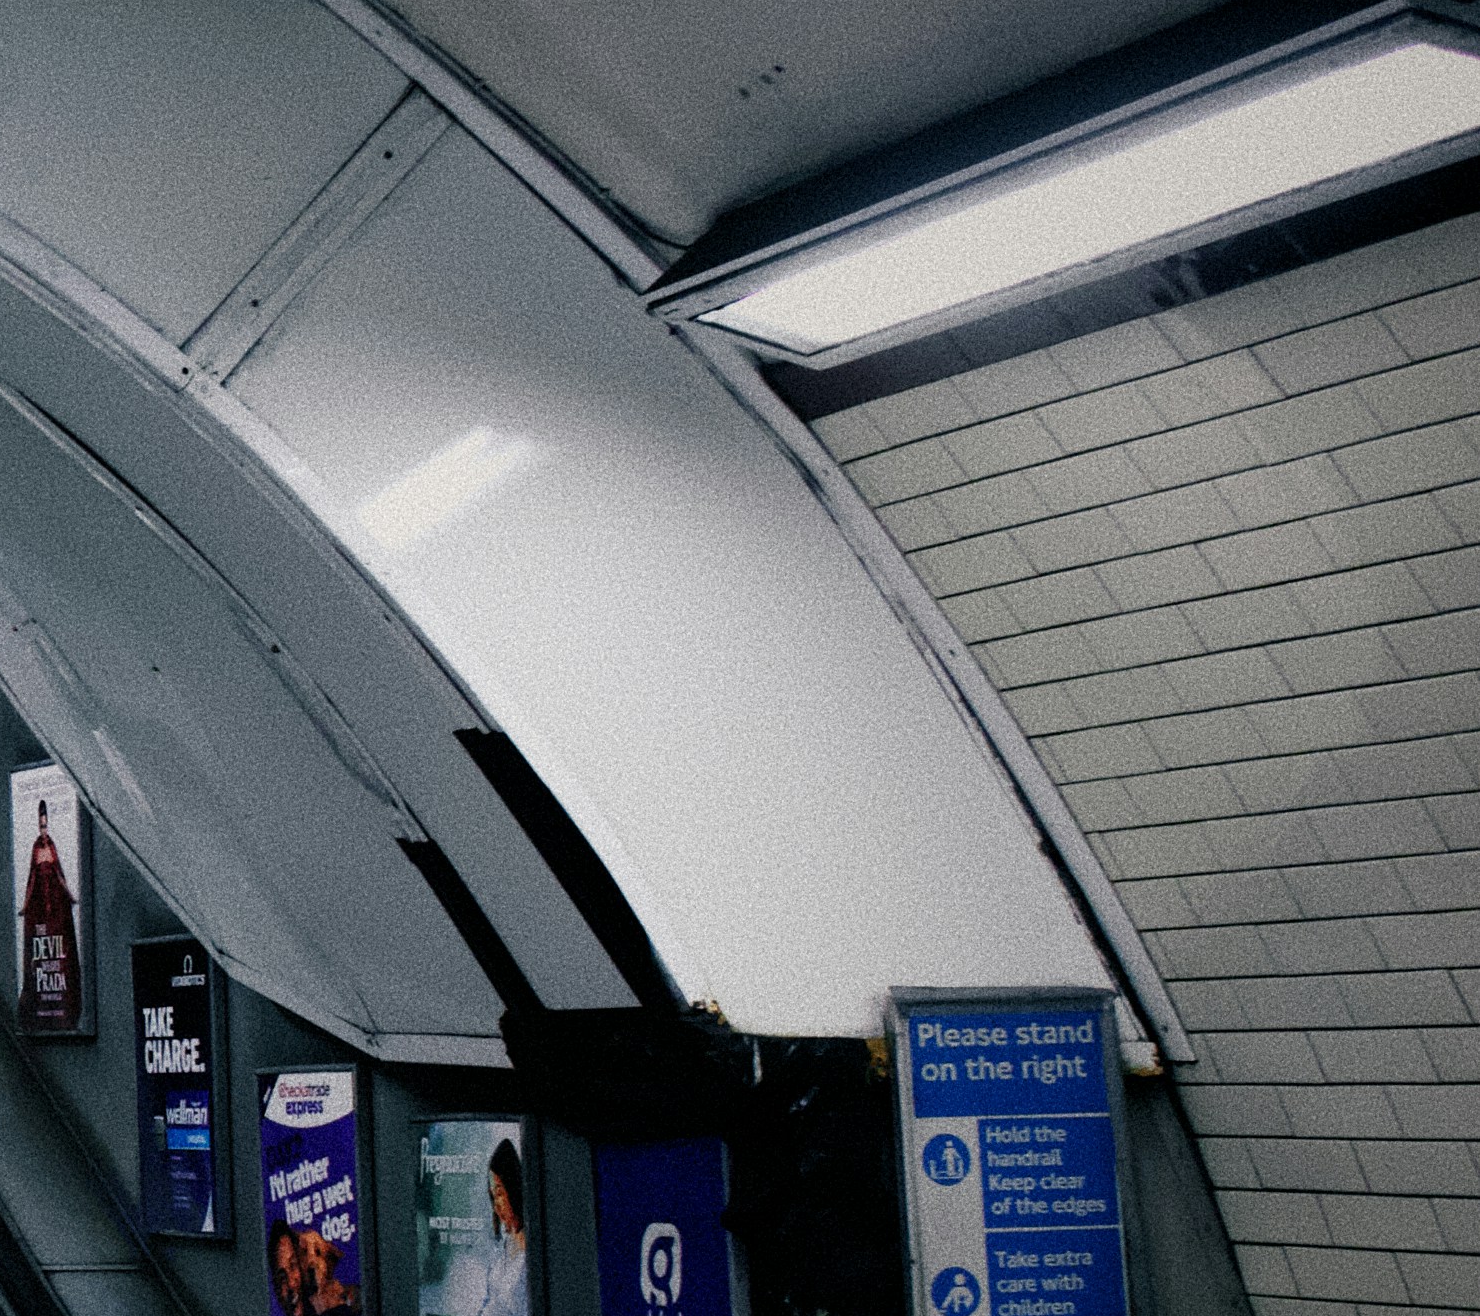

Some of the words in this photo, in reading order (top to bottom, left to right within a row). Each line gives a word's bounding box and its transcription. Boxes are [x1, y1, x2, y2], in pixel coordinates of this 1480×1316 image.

[32, 934, 67, 961] DEVIL
[36, 967, 67, 993] PRADA
[142, 1006, 175, 1038] TAKE
[917, 1022, 1007, 1048] Please
[1016, 1019, 1095, 1045] stand
[144, 1037, 206, 1074] CHARGE.
[921, 1062, 958, 1082] on
[965, 1055, 1014, 1081] the
[1022, 1054, 1088, 1085] right
[286, 1100, 324, 1118] express
[986, 1125, 1031, 1143] Hold
[1034, 1125, 1068, 1143] the
[987, 1148, 1064, 1167] handrail
[269, 1170, 287, 1203] I'd
[286, 1155, 331, 1195] rather
[988, 1173, 1037, 1194] Keep
[1040, 1173, 1086, 1191] clear
[284, 1195, 314, 1228] hug
[312, 1190, 324, 1215] a
[322, 1174, 355, 1210] wet
[990, 1197, 1012, 1216] of
[1015, 1196, 1049, 1215] the
[1052, 1196, 1107, 1217] edges
[321, 1211, 356, 1244] dog.
[994, 1251, 1040, 1269] Take
[1043, 1250, 1093, 1268] extra
[996, 1277, 1038, 1293] care
[1040, 1273, 1085, 1291] with
[998, 1299, 1076, 1316] children
